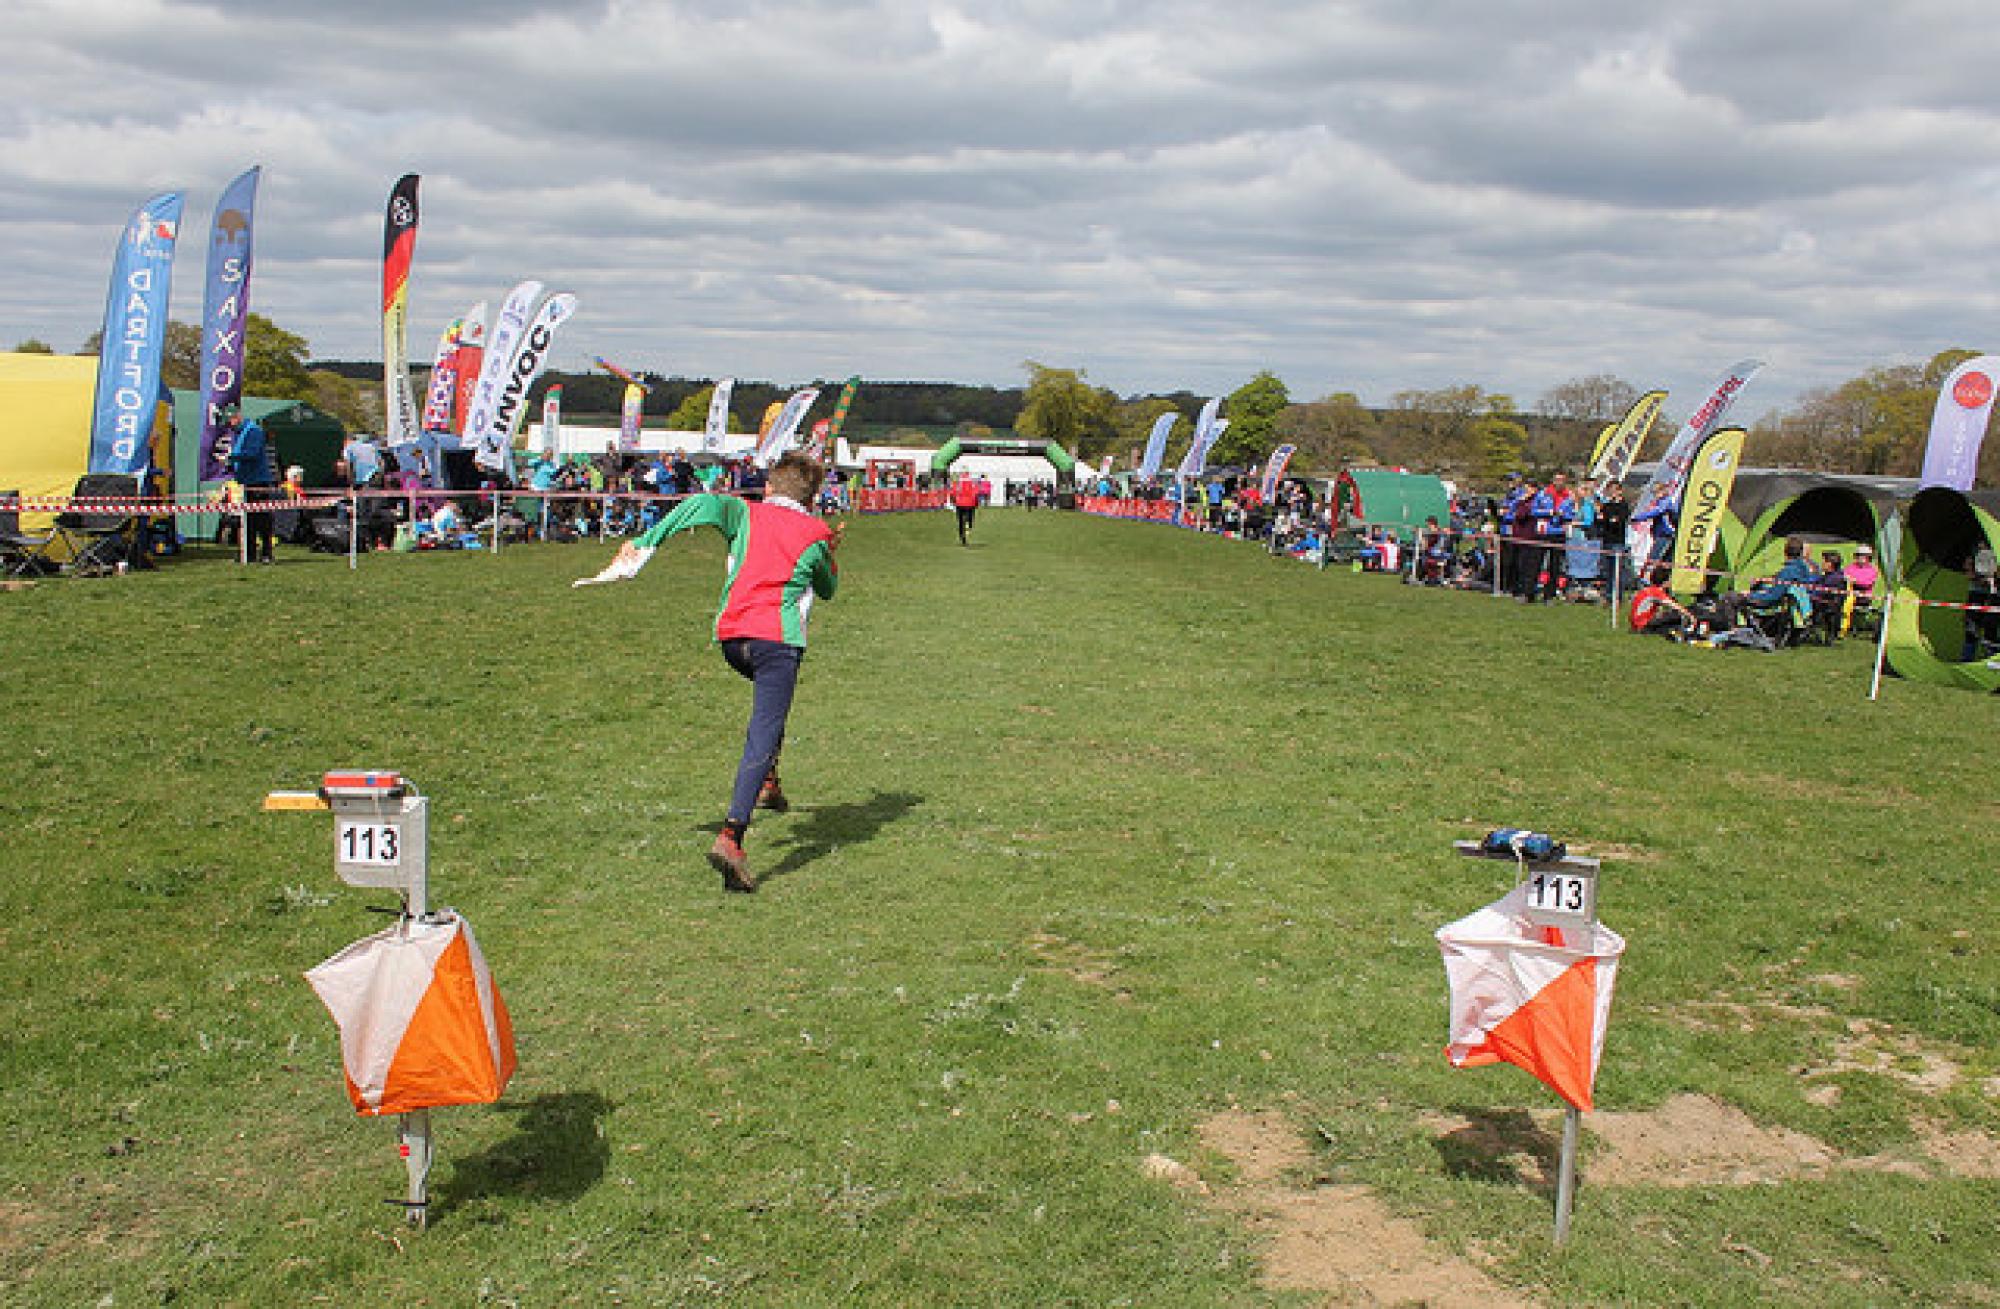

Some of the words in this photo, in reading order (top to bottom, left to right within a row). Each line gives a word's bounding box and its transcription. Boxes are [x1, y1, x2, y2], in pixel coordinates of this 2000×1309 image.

[494, 325, 551, 432] INVOC
[342, 828, 398, 860] 113
[1533, 875, 1582, 910] 113
